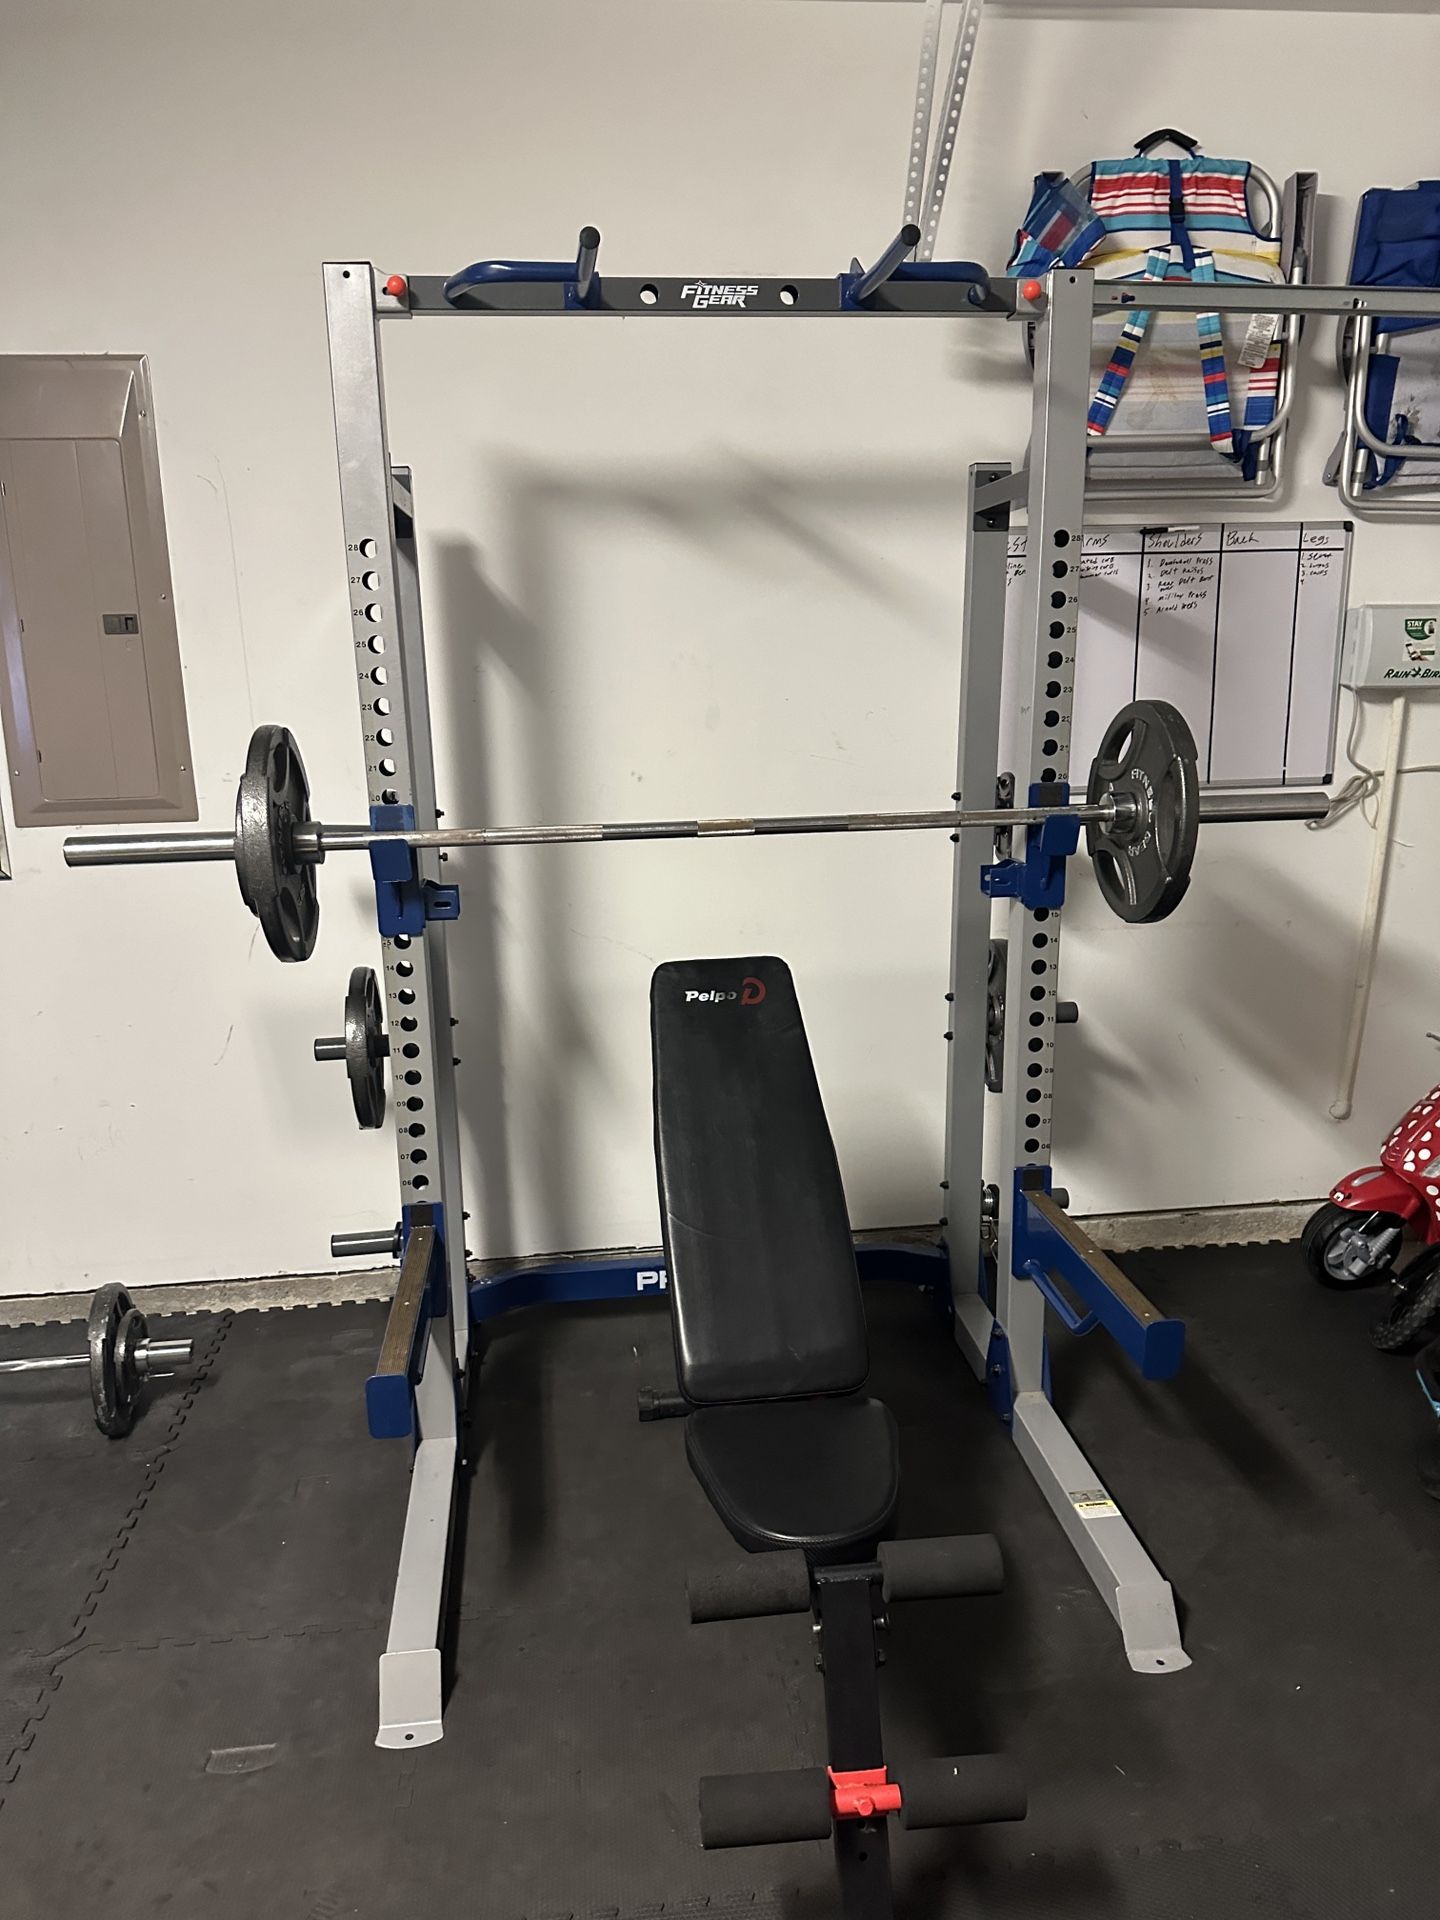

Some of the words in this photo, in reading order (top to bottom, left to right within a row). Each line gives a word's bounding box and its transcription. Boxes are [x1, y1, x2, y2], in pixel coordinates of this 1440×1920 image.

[680, 282, 759, 299] FITNESS
[692, 294, 746, 309] GEAR
[1071, 534, 1081, 542] 28
[1147, 532, 1203, 548] Shoulders
[1226, 530, 1260, 546] Back
[1303, 532, 1329, 546] Legs
[348, 544, 359, 552] 28
[350, 576, 361, 584] 27
[1406, 620, 1423, 628] STAY
[1383, 668, 1411, 679] RAIN
[1420, 668, 1440, 679] BIR
